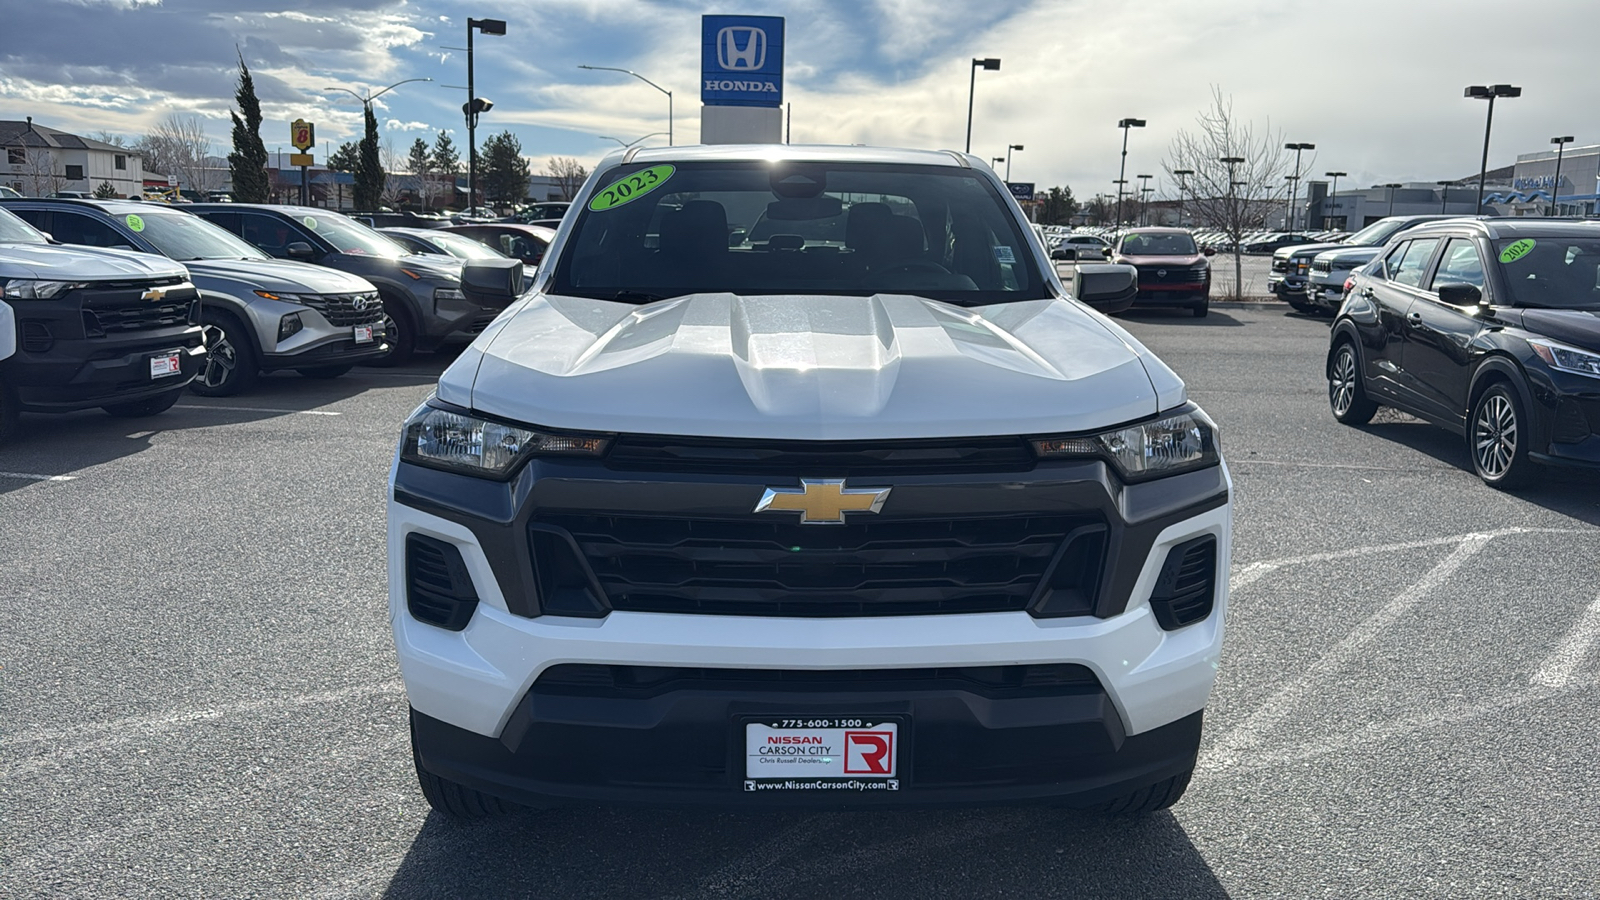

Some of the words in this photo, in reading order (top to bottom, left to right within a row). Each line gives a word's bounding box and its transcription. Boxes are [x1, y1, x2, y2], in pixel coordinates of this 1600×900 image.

[704, 80, 779, 93] HONDA
[602, 169, 659, 206] 2023
[1503, 240, 1530, 261] 2024
[782, 719, 862, 728] 775-600-1500
[767, 736, 823, 745] NISSAN
[759, 746, 806, 755] CARSON
[808, 746, 831, 755] CITY
[757, 780, 886, 791] www.NissanCarsonCity.com
